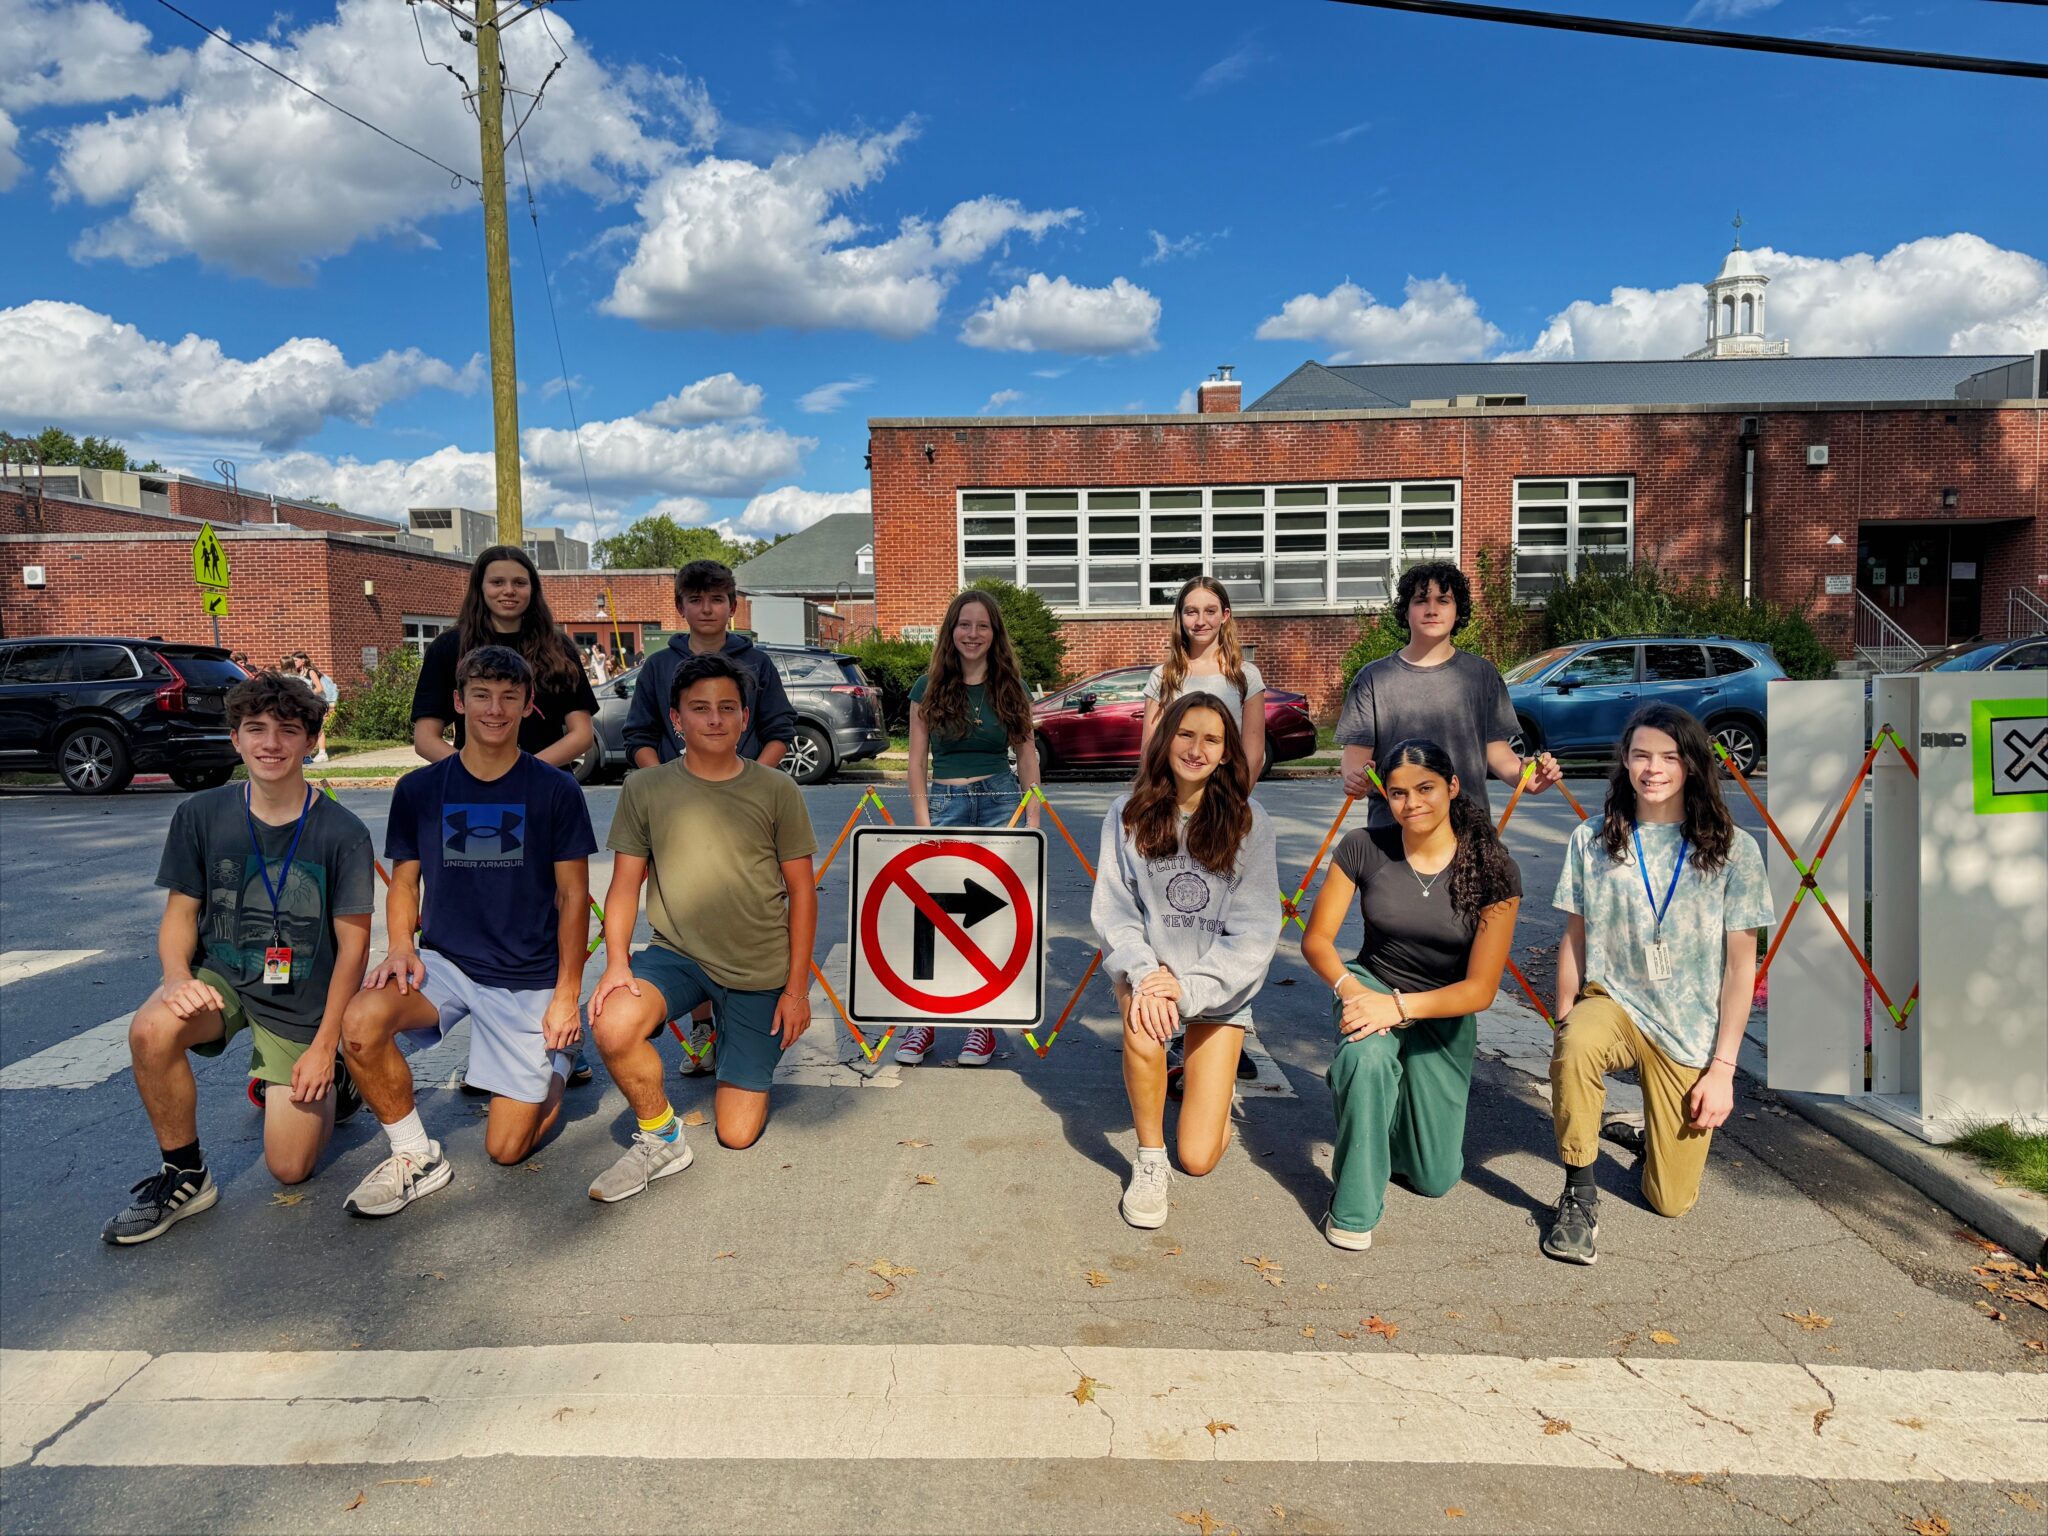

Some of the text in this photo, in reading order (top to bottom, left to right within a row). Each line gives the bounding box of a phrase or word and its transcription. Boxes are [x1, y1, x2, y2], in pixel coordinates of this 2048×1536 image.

[1874, 571, 1884, 580] 16
[1908, 571, 1918, 579] 16
[442, 860, 524, 868] UNDER ARMOUR
[1155, 855, 1187, 872] CITY
[1161, 914, 1226, 934] NEW YOR
